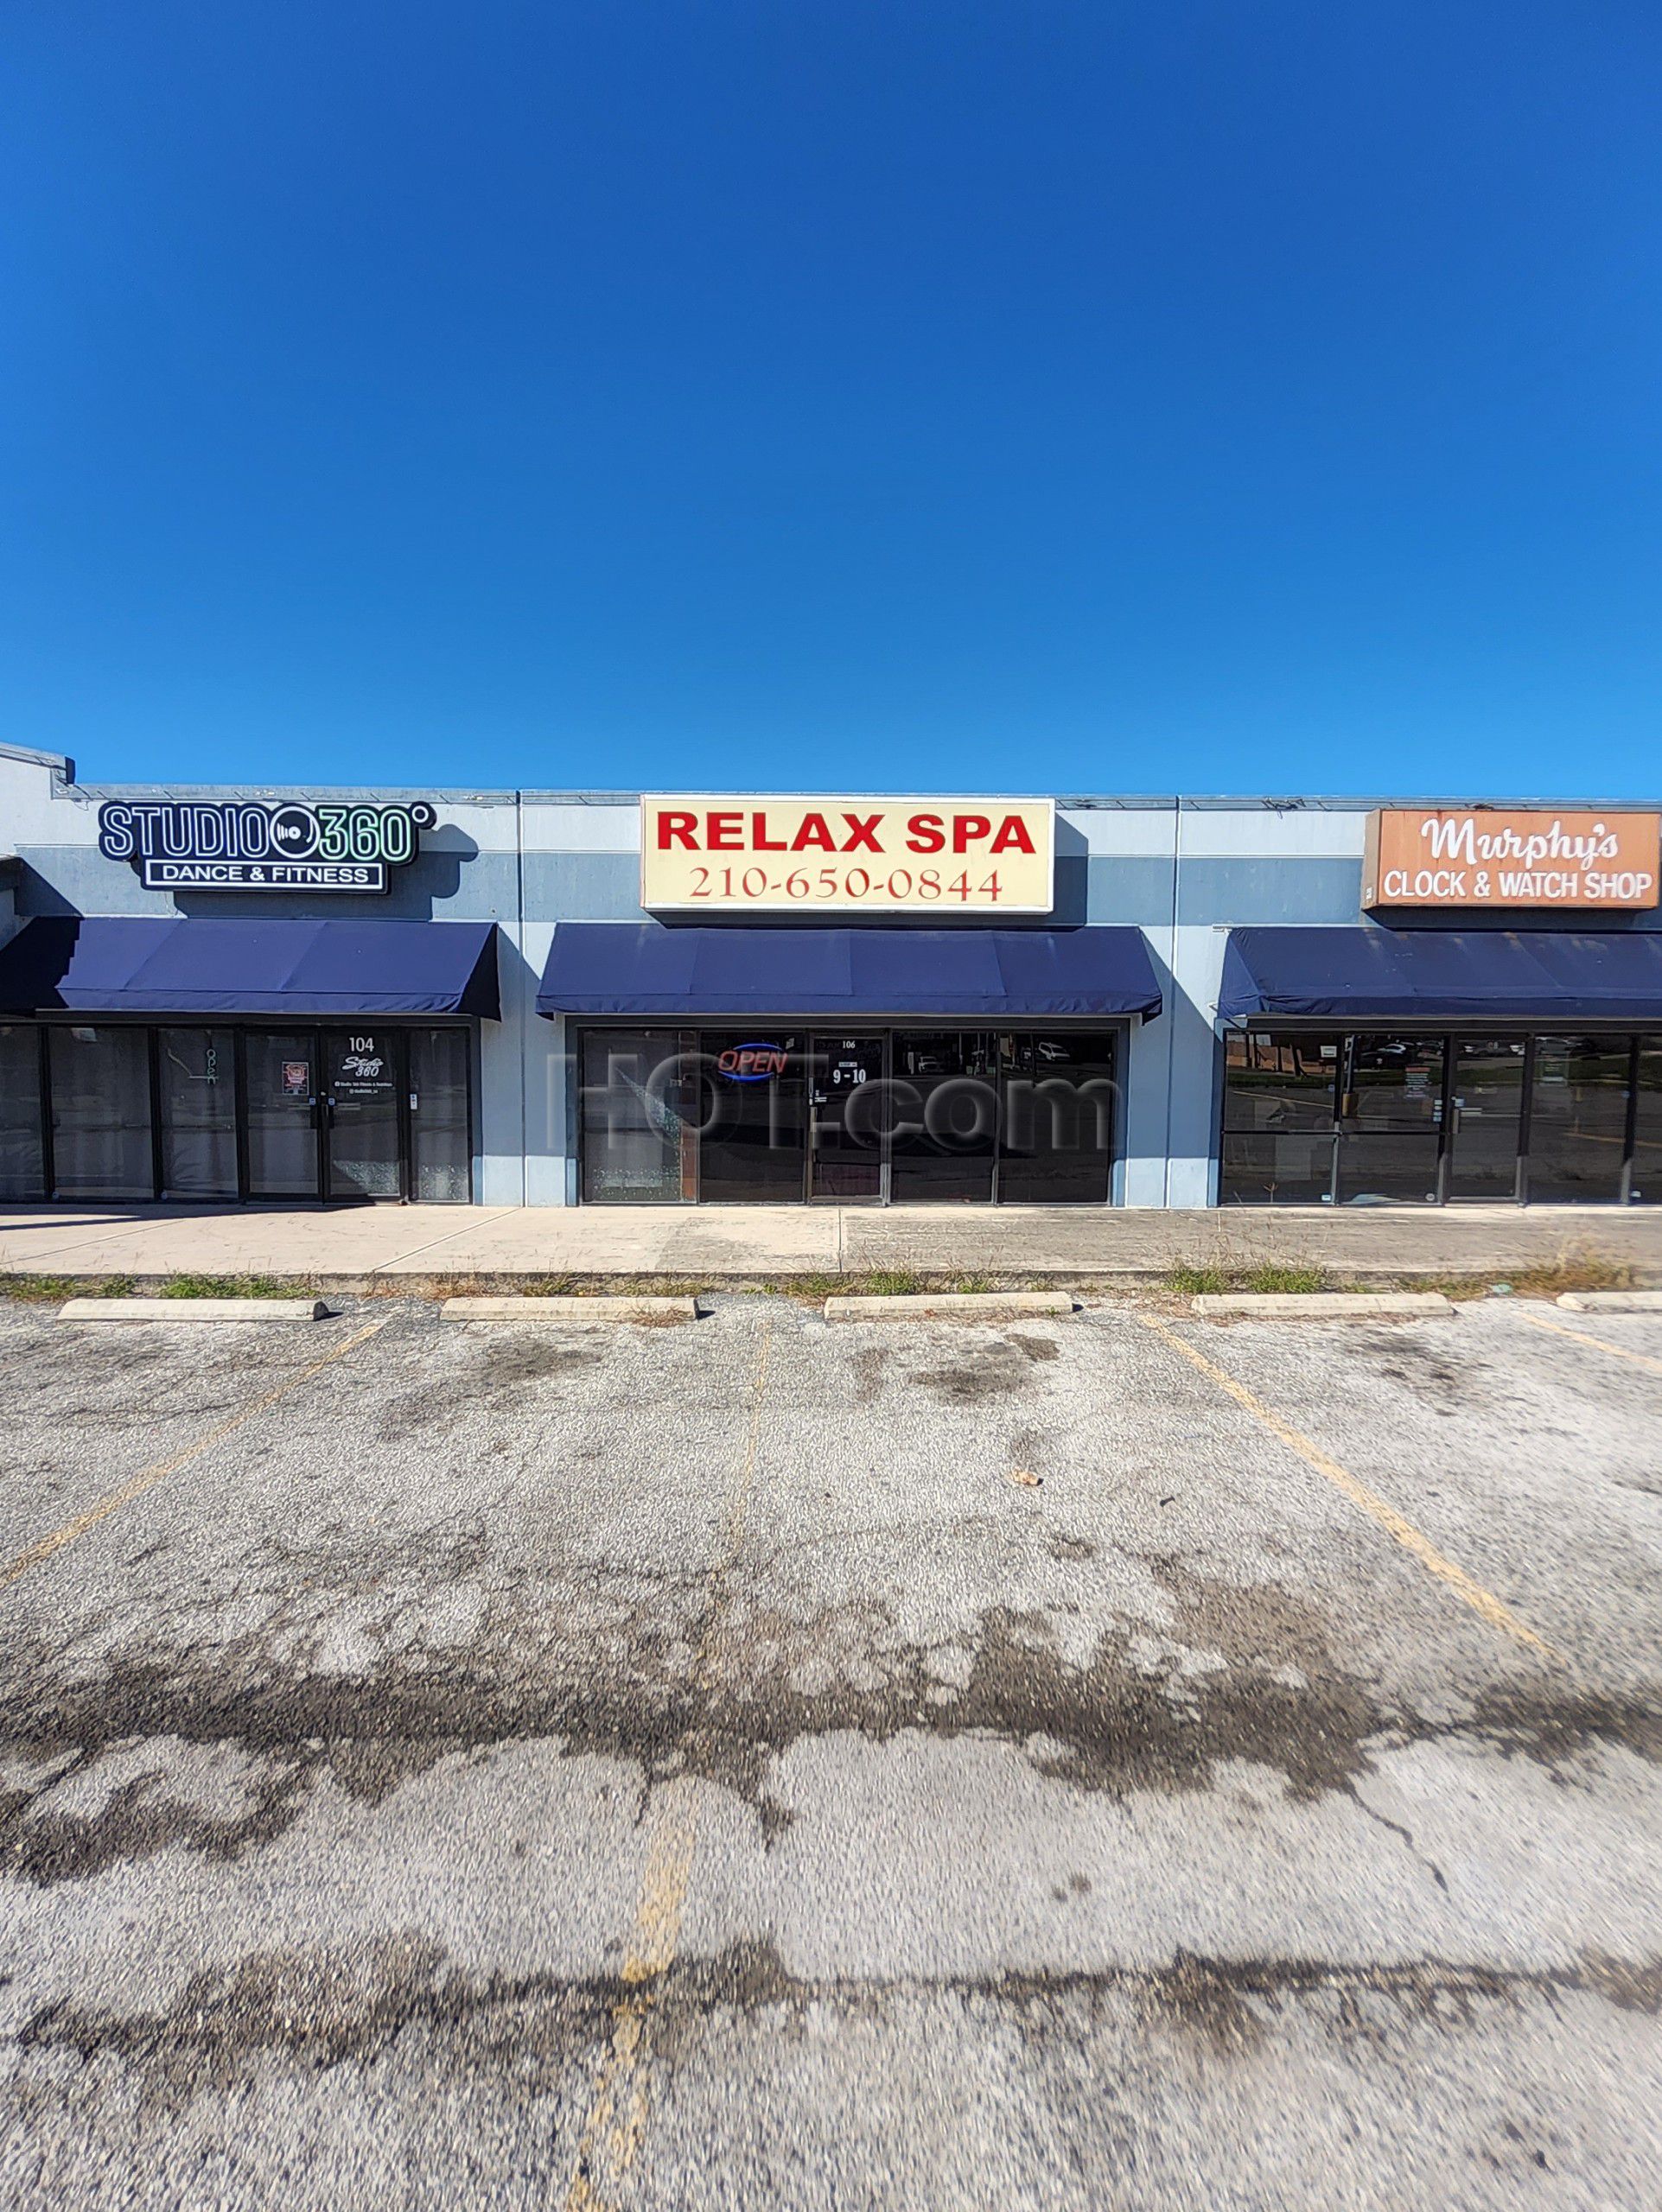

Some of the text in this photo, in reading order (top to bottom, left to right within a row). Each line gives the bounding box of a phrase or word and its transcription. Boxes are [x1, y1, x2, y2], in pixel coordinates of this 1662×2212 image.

[103, 805, 270, 859] STUDIO
[657, 810, 1036, 854] RELAX SPA
[1421, 818, 1619, 871] Murphy's
[162, 865, 369, 883] DANCE & FITNESS
[689, 867, 1003, 902] 210-650-0844
[1384, 870, 1652, 899] CLOCK & WATCH SHOP
[348, 1037, 374, 1052] 104
[843, 1040, 856, 1049] 106
[355, 1066, 379, 1077] 360
[718, 1050, 788, 1073] OPEN
